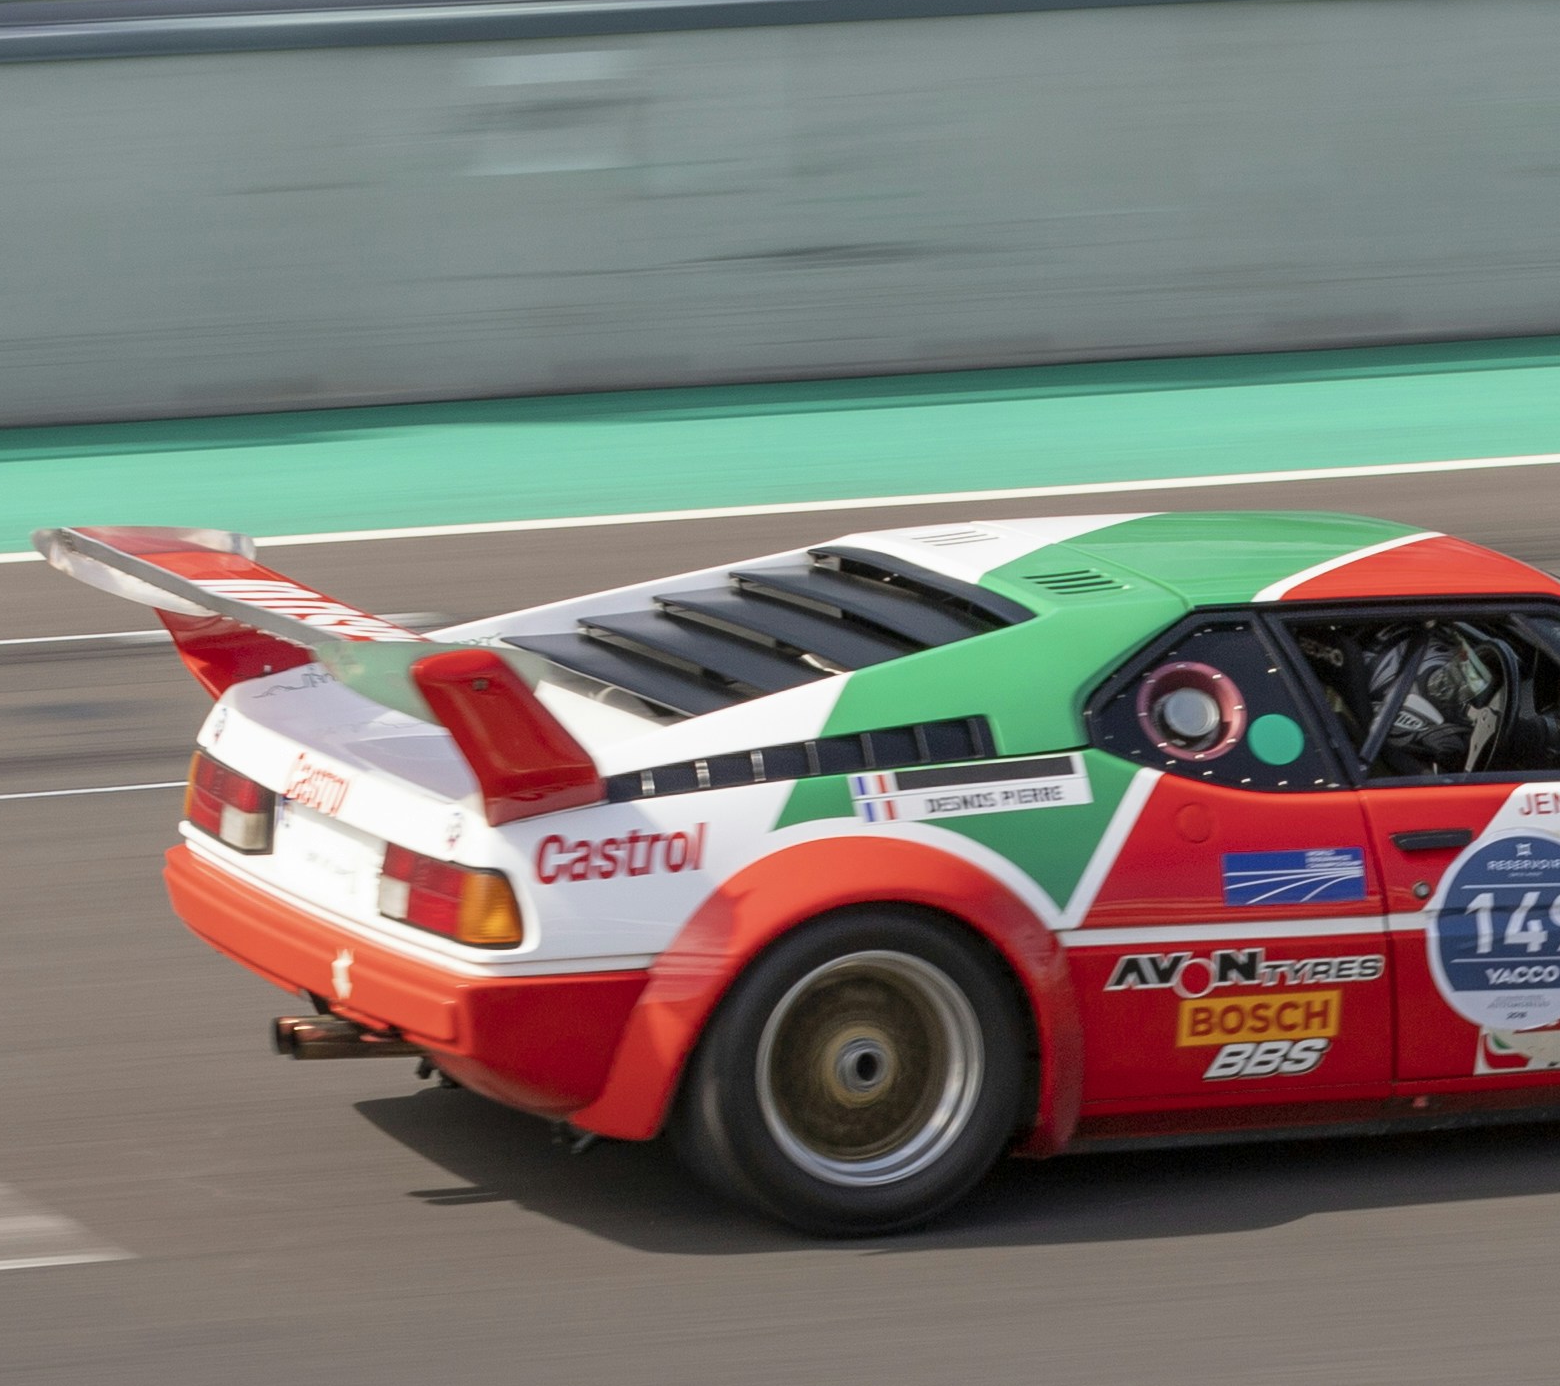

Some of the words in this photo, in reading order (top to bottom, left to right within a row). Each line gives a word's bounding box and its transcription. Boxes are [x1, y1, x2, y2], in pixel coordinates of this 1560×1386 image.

[535, 822, 710, 885] Castrol
[1103, 947, 1266, 999] AVON
[1258, 954, 1386, 987] TYRES
[1485, 964, 1560, 986] YACCO
[1189, 998, 1332, 1038] BOSCH
[1202, 1037, 1332, 1081] BBS
